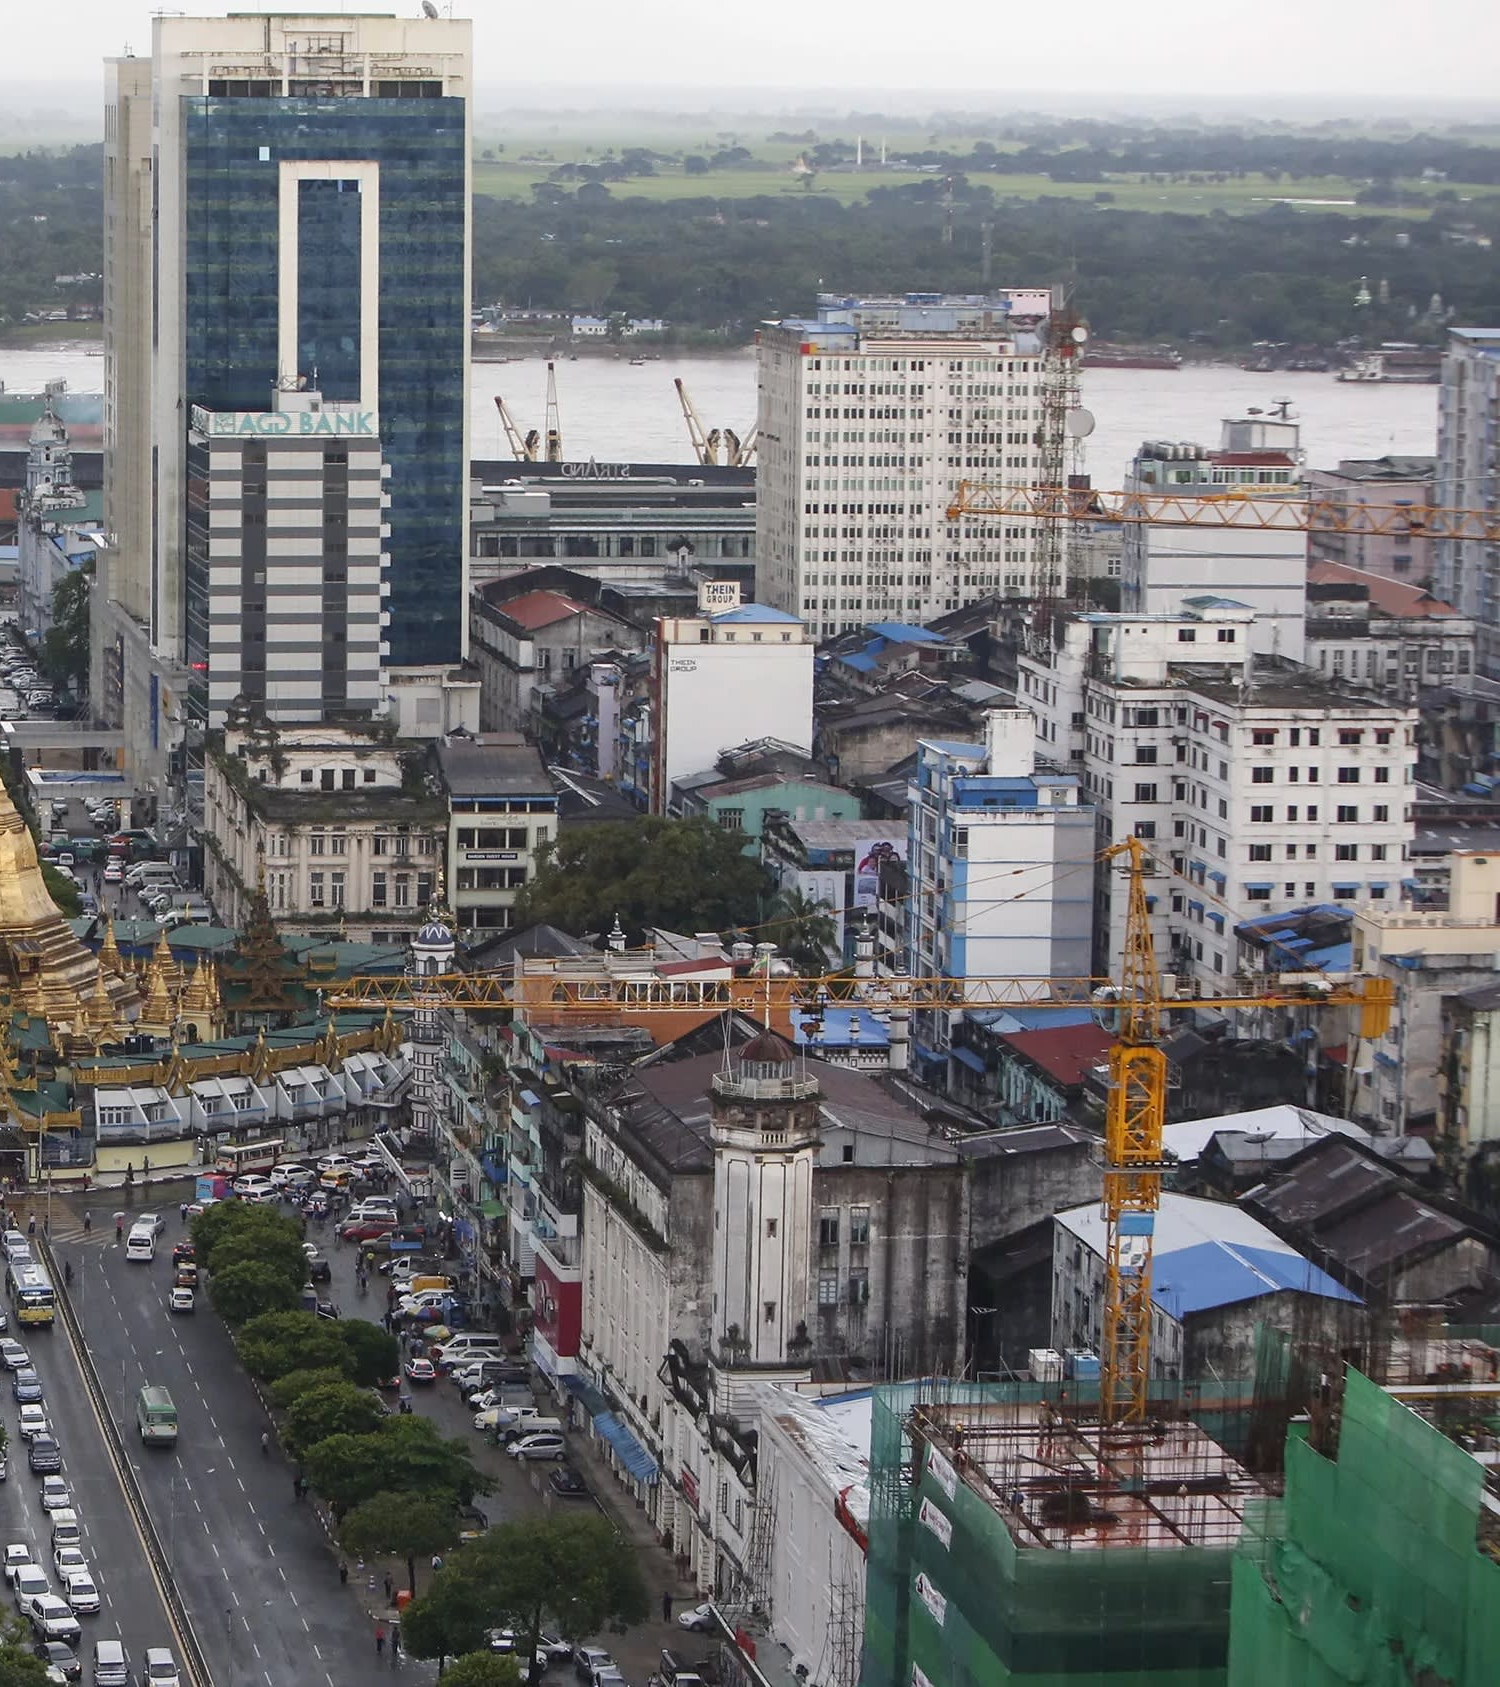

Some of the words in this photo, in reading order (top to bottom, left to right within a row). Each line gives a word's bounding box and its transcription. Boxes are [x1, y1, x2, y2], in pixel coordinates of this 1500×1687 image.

[239, 411, 292, 433] AGD
[300, 411, 374, 433] BANK
[706, 585, 735, 594] THEIN
[707, 595, 733, 603] GROUP
